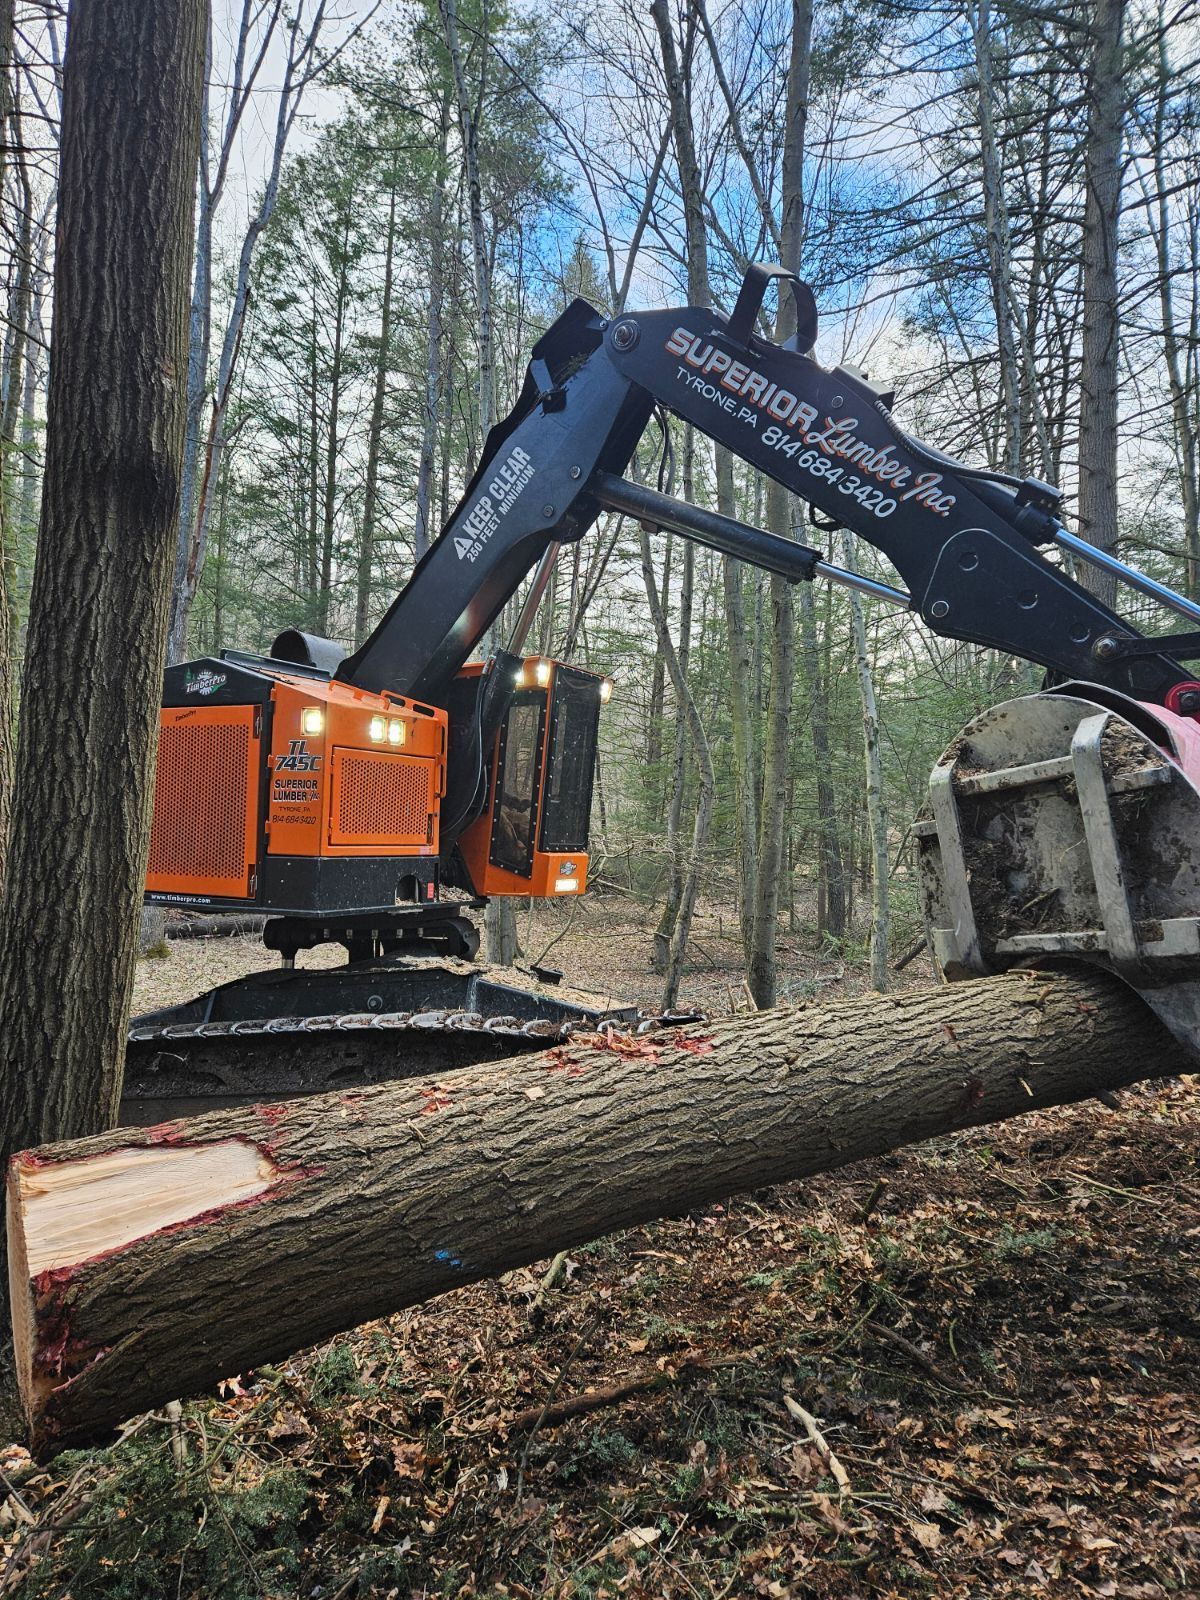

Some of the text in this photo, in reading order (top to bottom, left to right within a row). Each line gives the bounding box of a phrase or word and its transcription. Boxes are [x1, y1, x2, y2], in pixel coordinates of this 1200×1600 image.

[665, 327, 957, 518] SUPERIOR Lumber Inc.
[462, 446, 532, 540] KEEP CLEAR
[466, 464, 536, 563] 250 FEET MINIMUM
[186, 673, 227, 694] TimberPro
[288, 739, 310, 757] TL
[274, 755, 323, 772] 745C
[274, 779, 318, 790] SUPERIOR
[272, 790, 307, 803] LUMBER
[151, 894, 211, 904] www.timberpro.com
